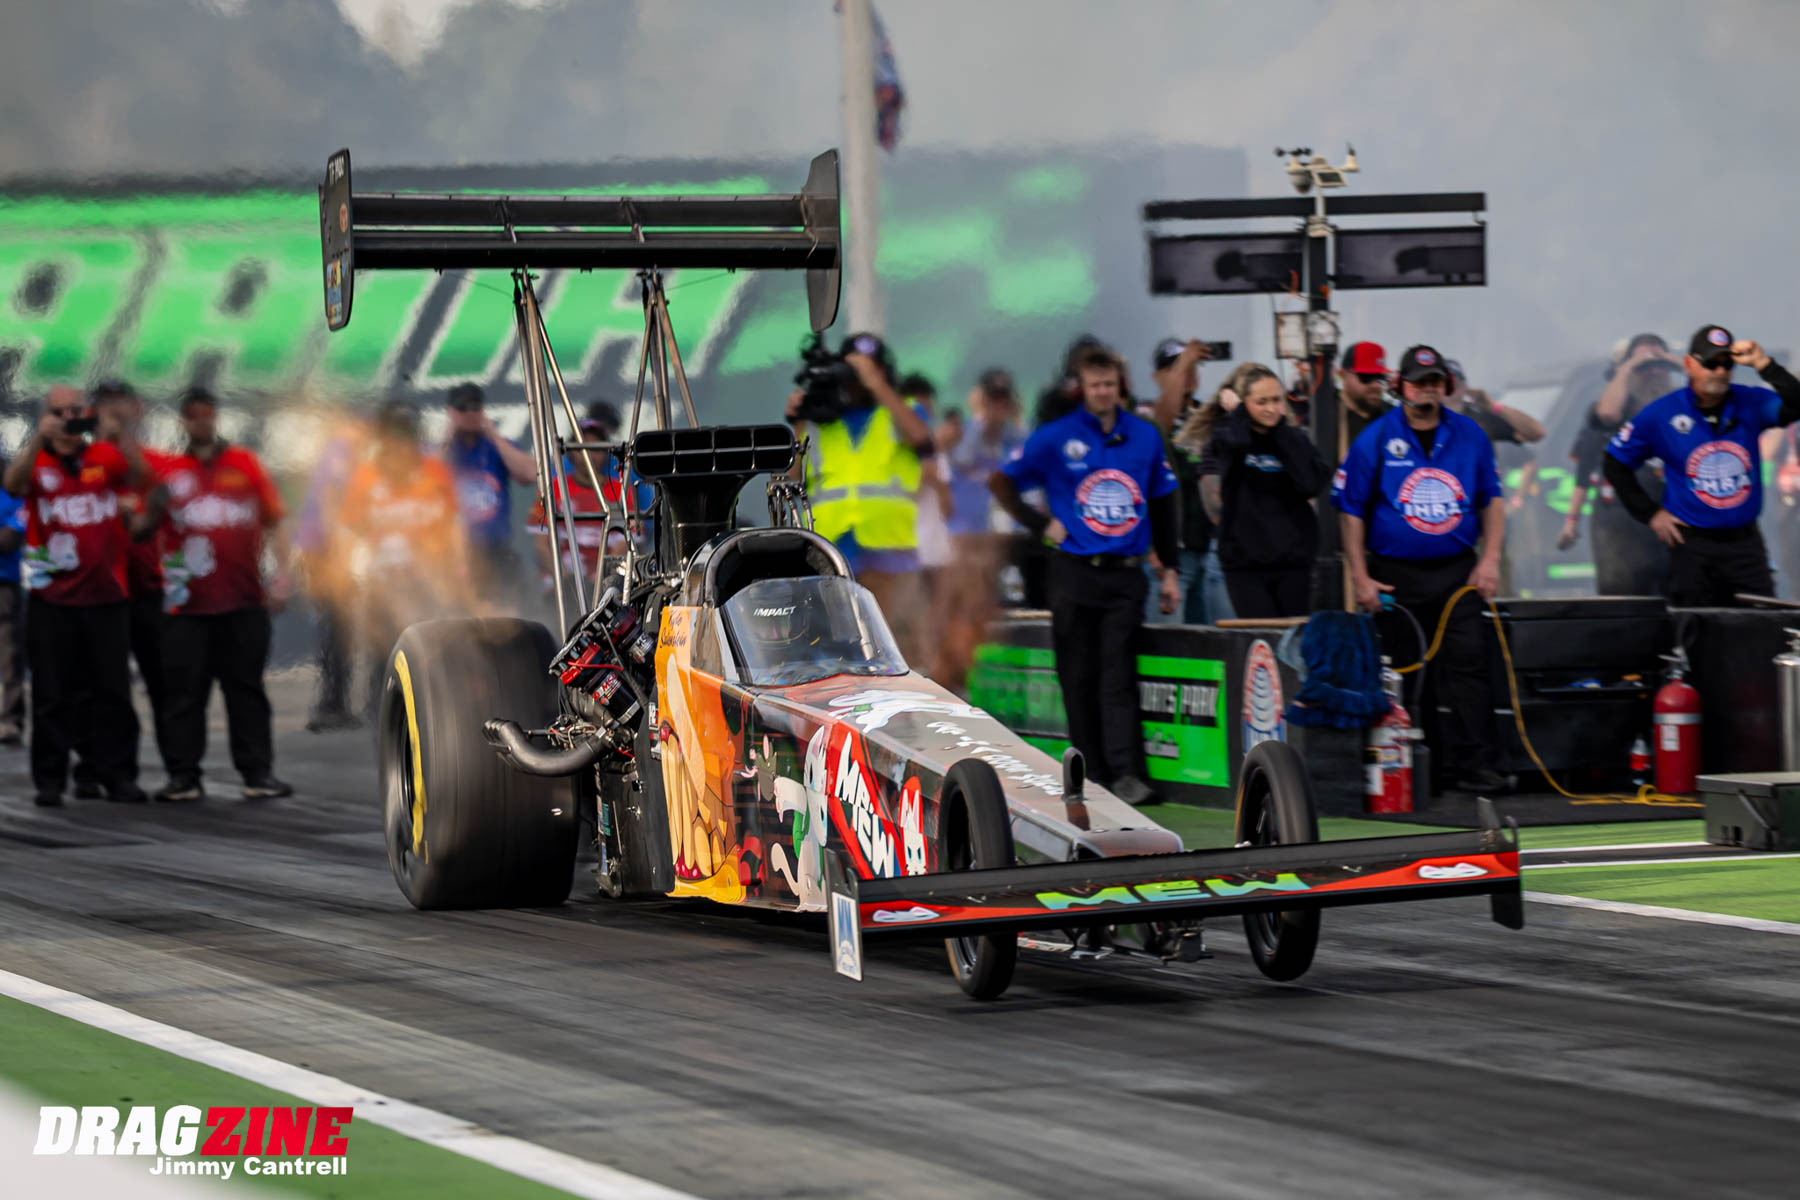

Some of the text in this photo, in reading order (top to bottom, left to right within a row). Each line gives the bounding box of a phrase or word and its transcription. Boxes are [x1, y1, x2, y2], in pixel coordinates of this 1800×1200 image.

[1404, 501, 1462, 517] IHRA
[753, 605, 797, 617] IMPACT
[1181, 684, 1218, 717] PARK
[1035, 872, 1311, 911] MEW
